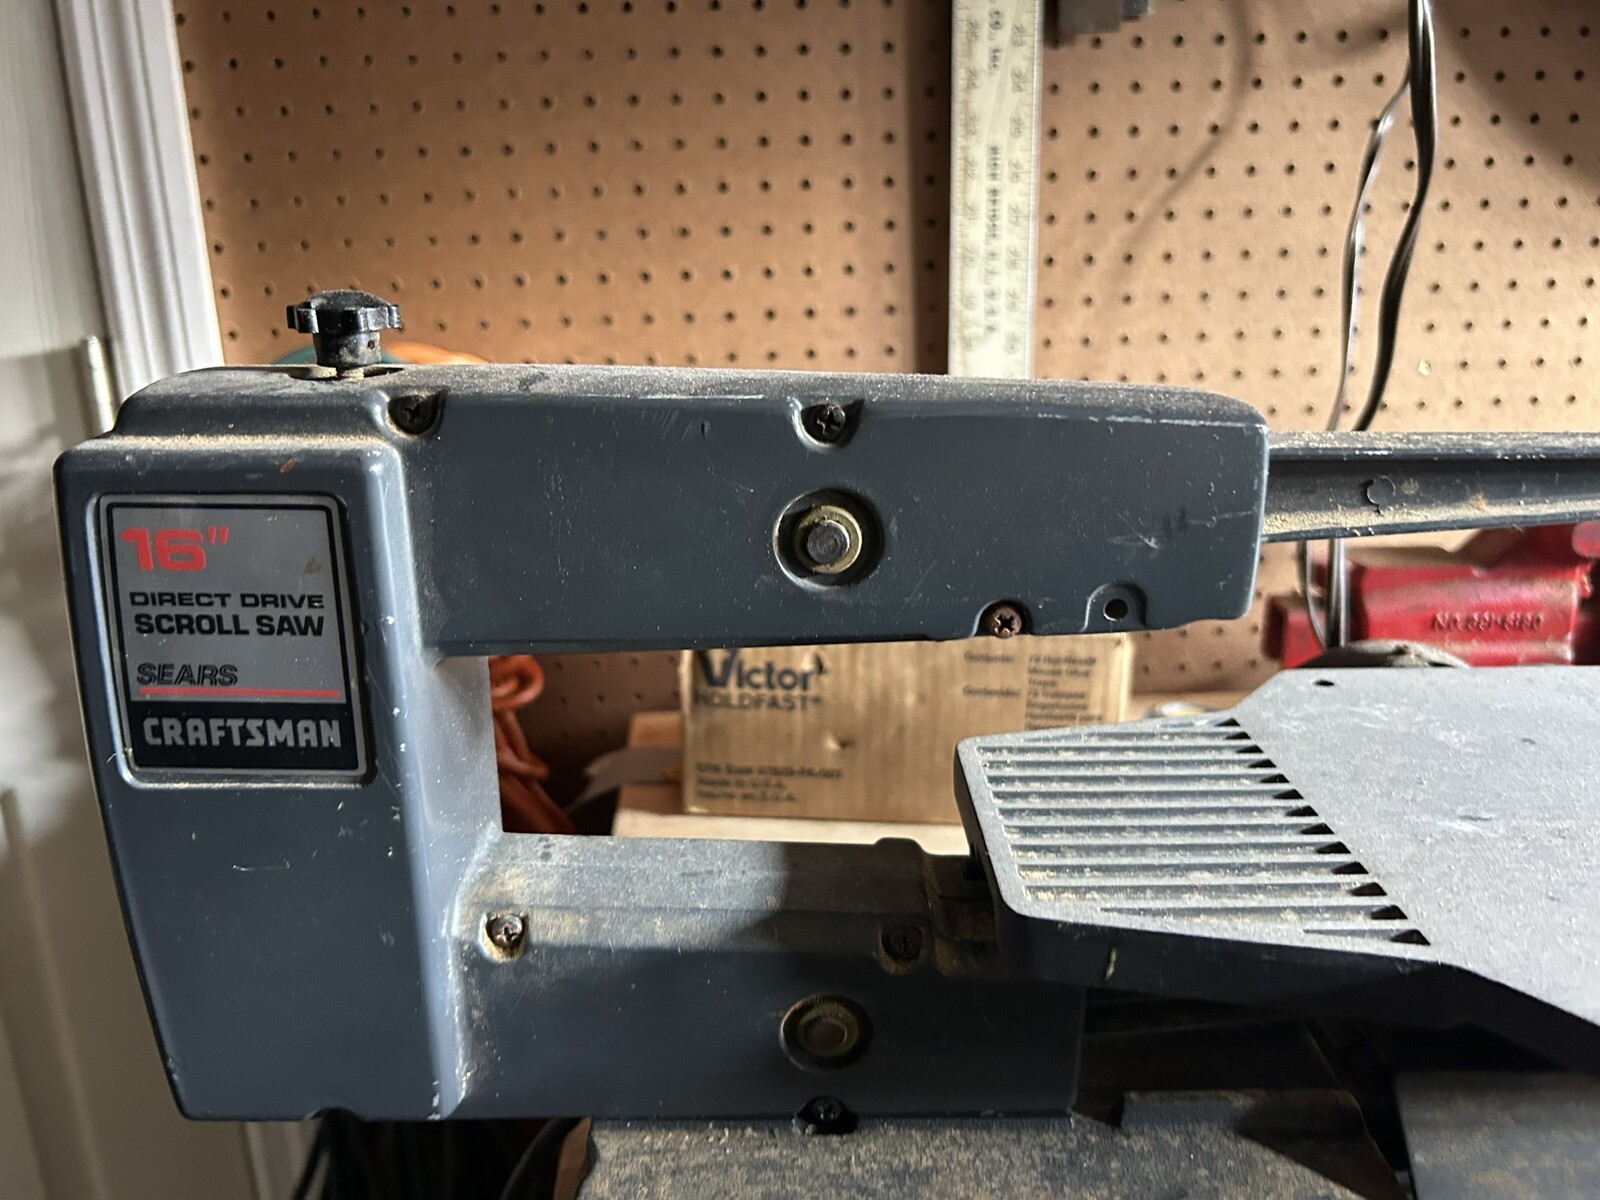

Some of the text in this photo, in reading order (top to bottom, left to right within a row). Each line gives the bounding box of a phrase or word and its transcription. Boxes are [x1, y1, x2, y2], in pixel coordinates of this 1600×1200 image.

[120, 525, 230, 572] 16"
[129, 591, 325, 609] DIRECT DRIVE
[134, 613, 324, 636] SCROLL SAW
[137, 663, 238, 686] SEARS
[692, 649, 813, 691] Victor
[143, 717, 341, 748] CRAFTSMAN
